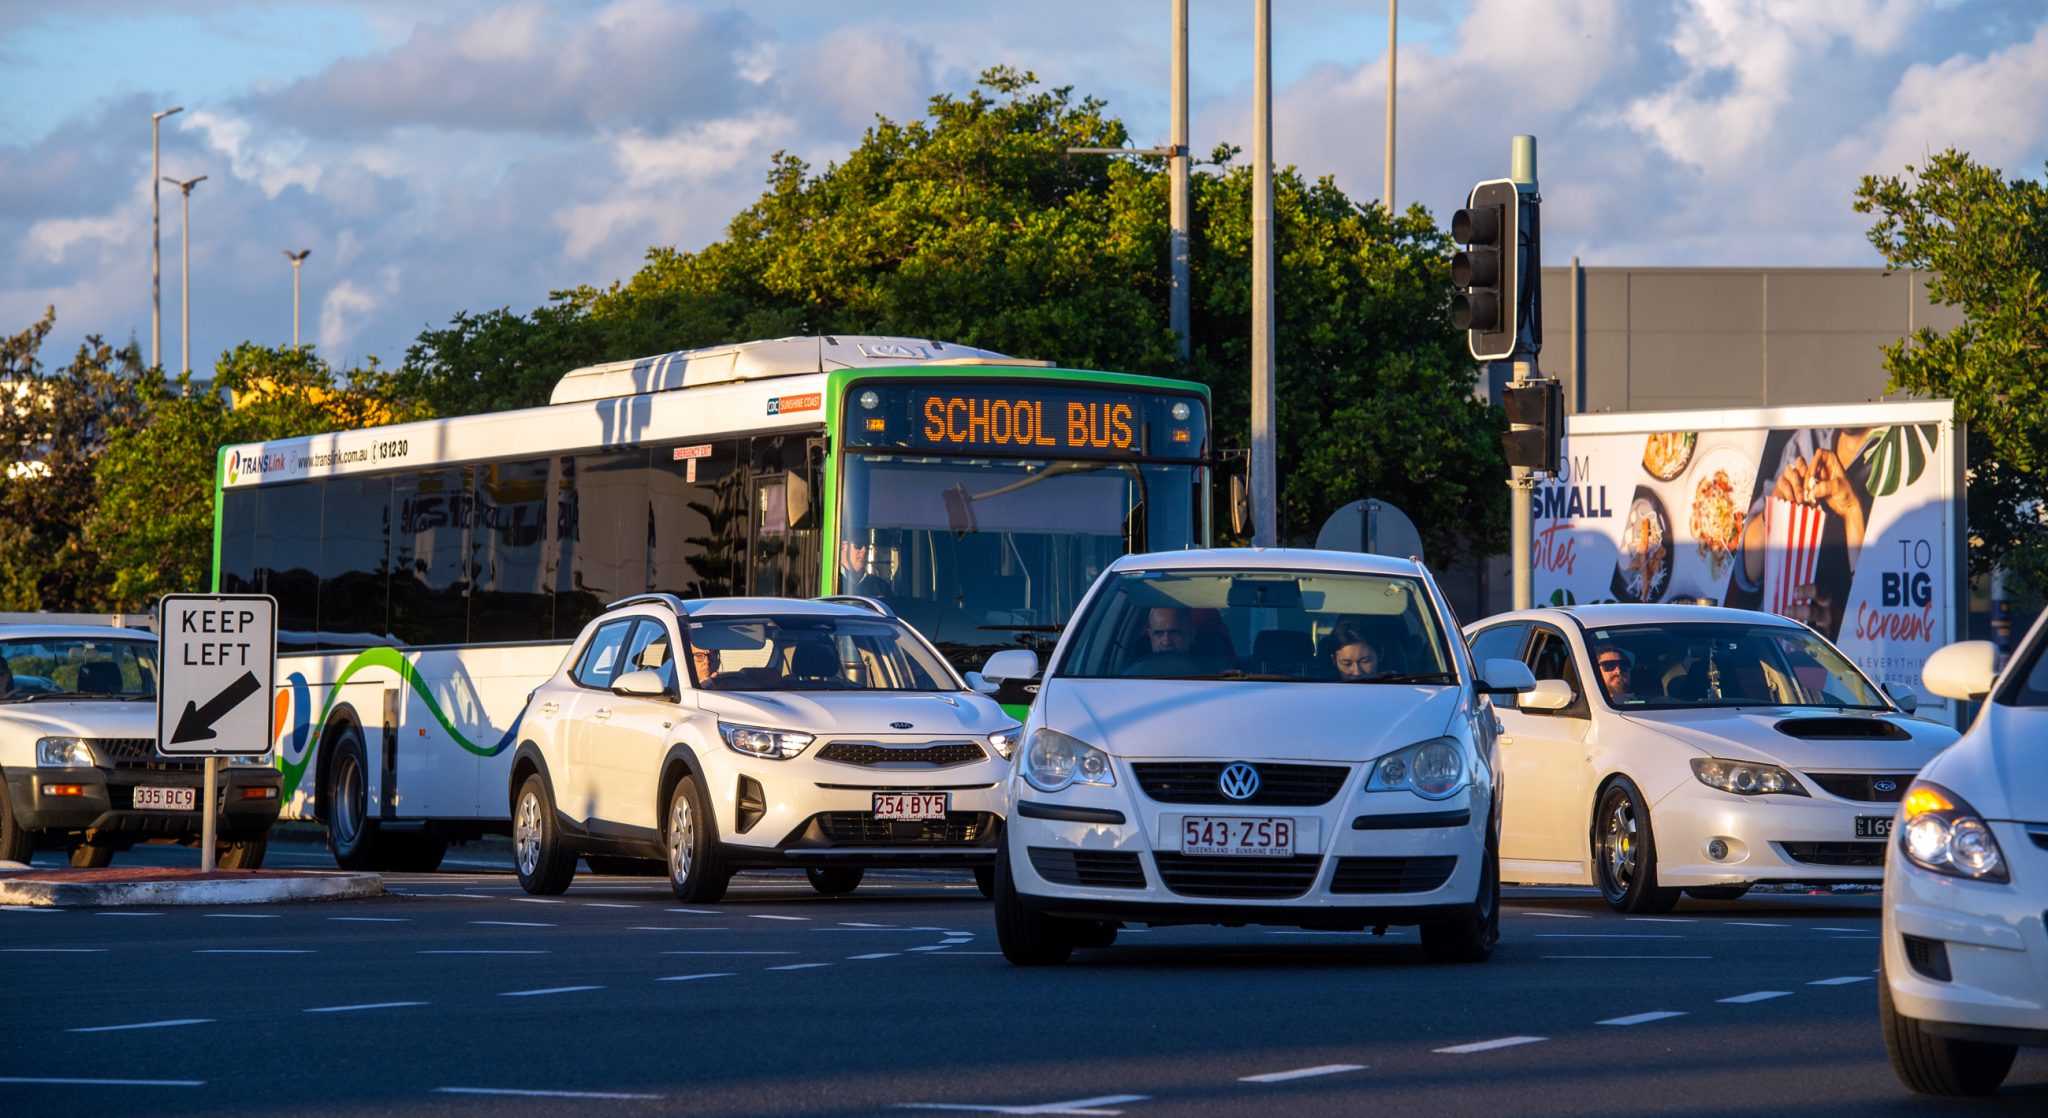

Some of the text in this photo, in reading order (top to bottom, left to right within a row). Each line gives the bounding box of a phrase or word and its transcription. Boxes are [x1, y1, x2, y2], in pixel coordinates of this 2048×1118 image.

[768, 396, 820, 412] CDC SUNSHINE COAST
[924, 397, 1133, 448] SCHOOL BUS
[242, 452, 285, 475] TRANSLink
[1558, 455, 1590, 484] OM
[1899, 539, 1931, 569] TO
[1882, 571, 1932, 607] BIG
[182, 610, 254, 633] KEEP
[1856, 601, 1935, 643] Screens
[184, 643, 250, 666] LEFT
[1867, 657, 1925, 668] EVERYTHIN
[1885, 674, 1920, 685] BETWE
